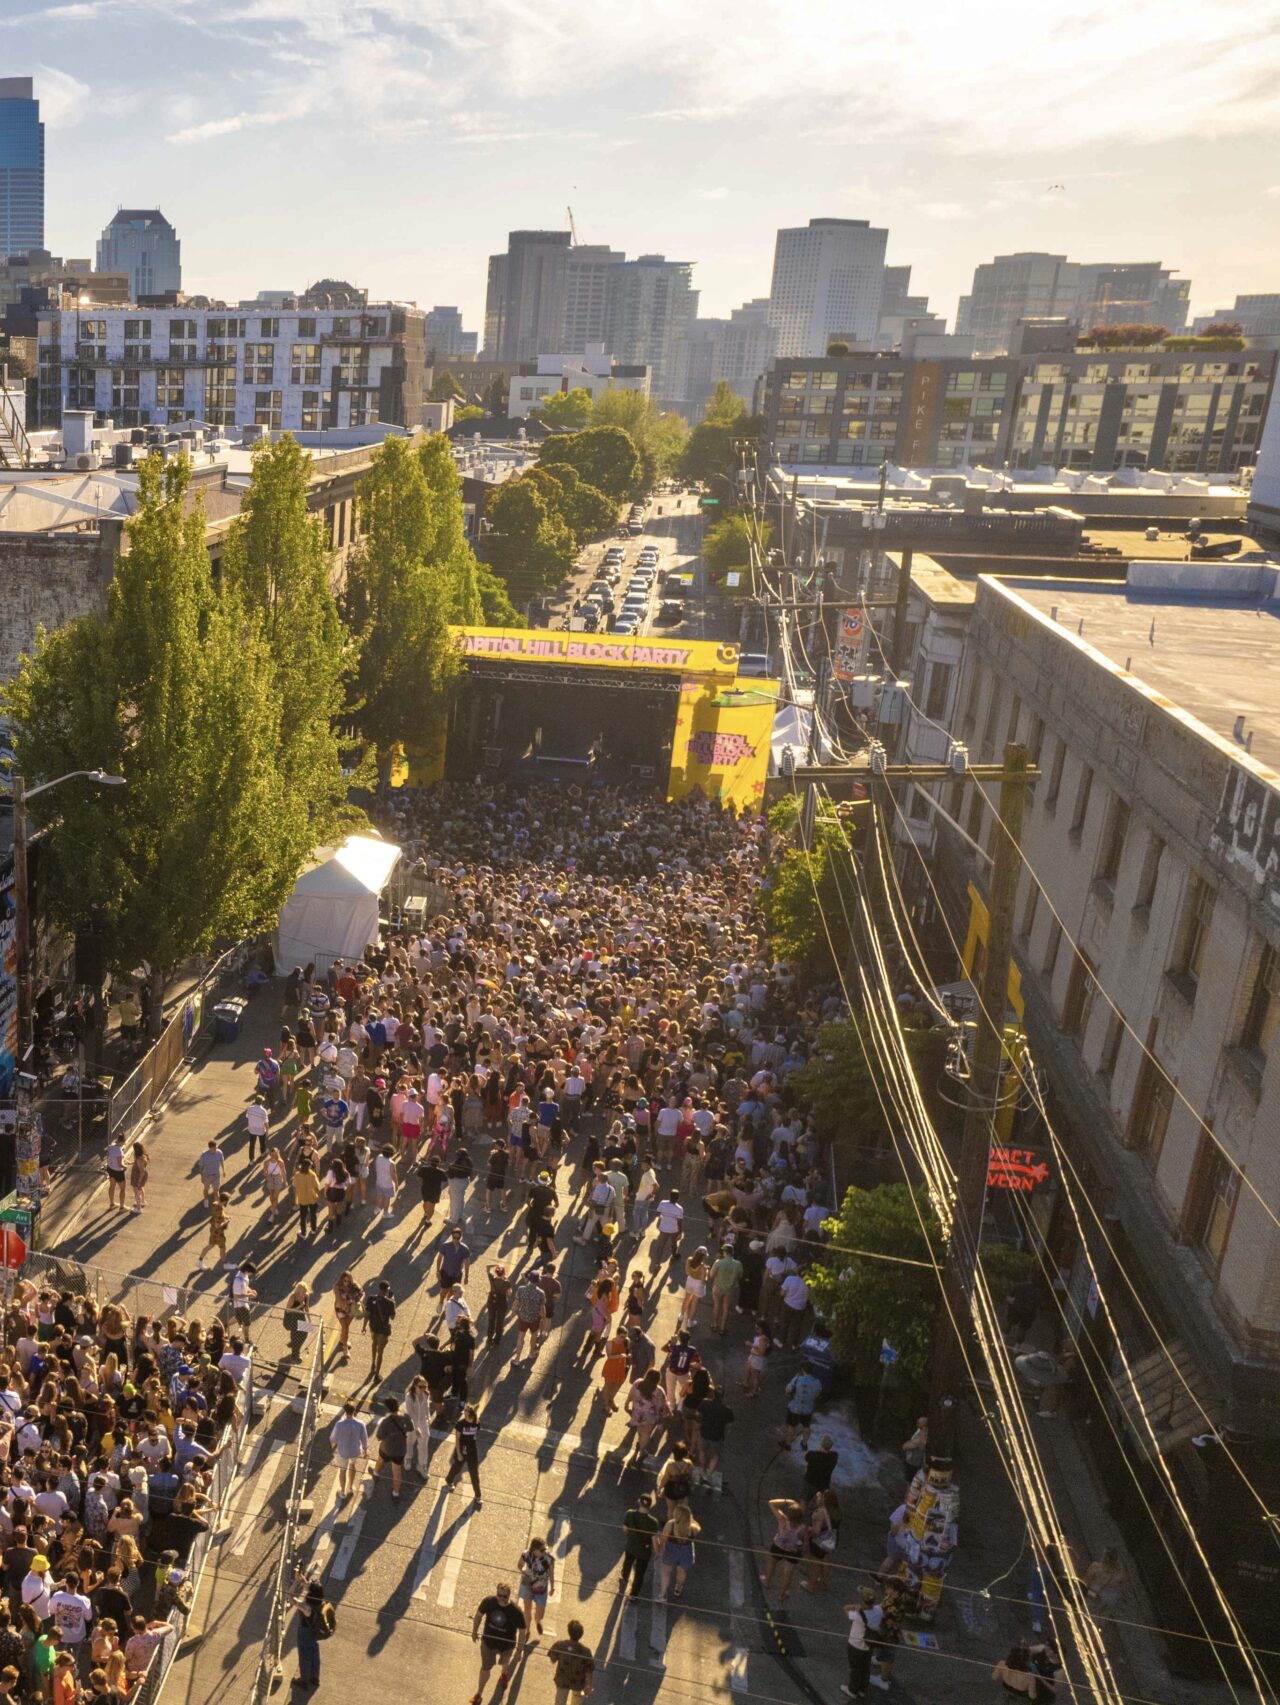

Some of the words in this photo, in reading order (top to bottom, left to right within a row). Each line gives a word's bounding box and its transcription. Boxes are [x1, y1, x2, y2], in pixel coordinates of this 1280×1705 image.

[526, 640, 564, 658] HILL
[568, 643, 626, 662] BLOCK
[629, 647, 691, 666] PARTY
